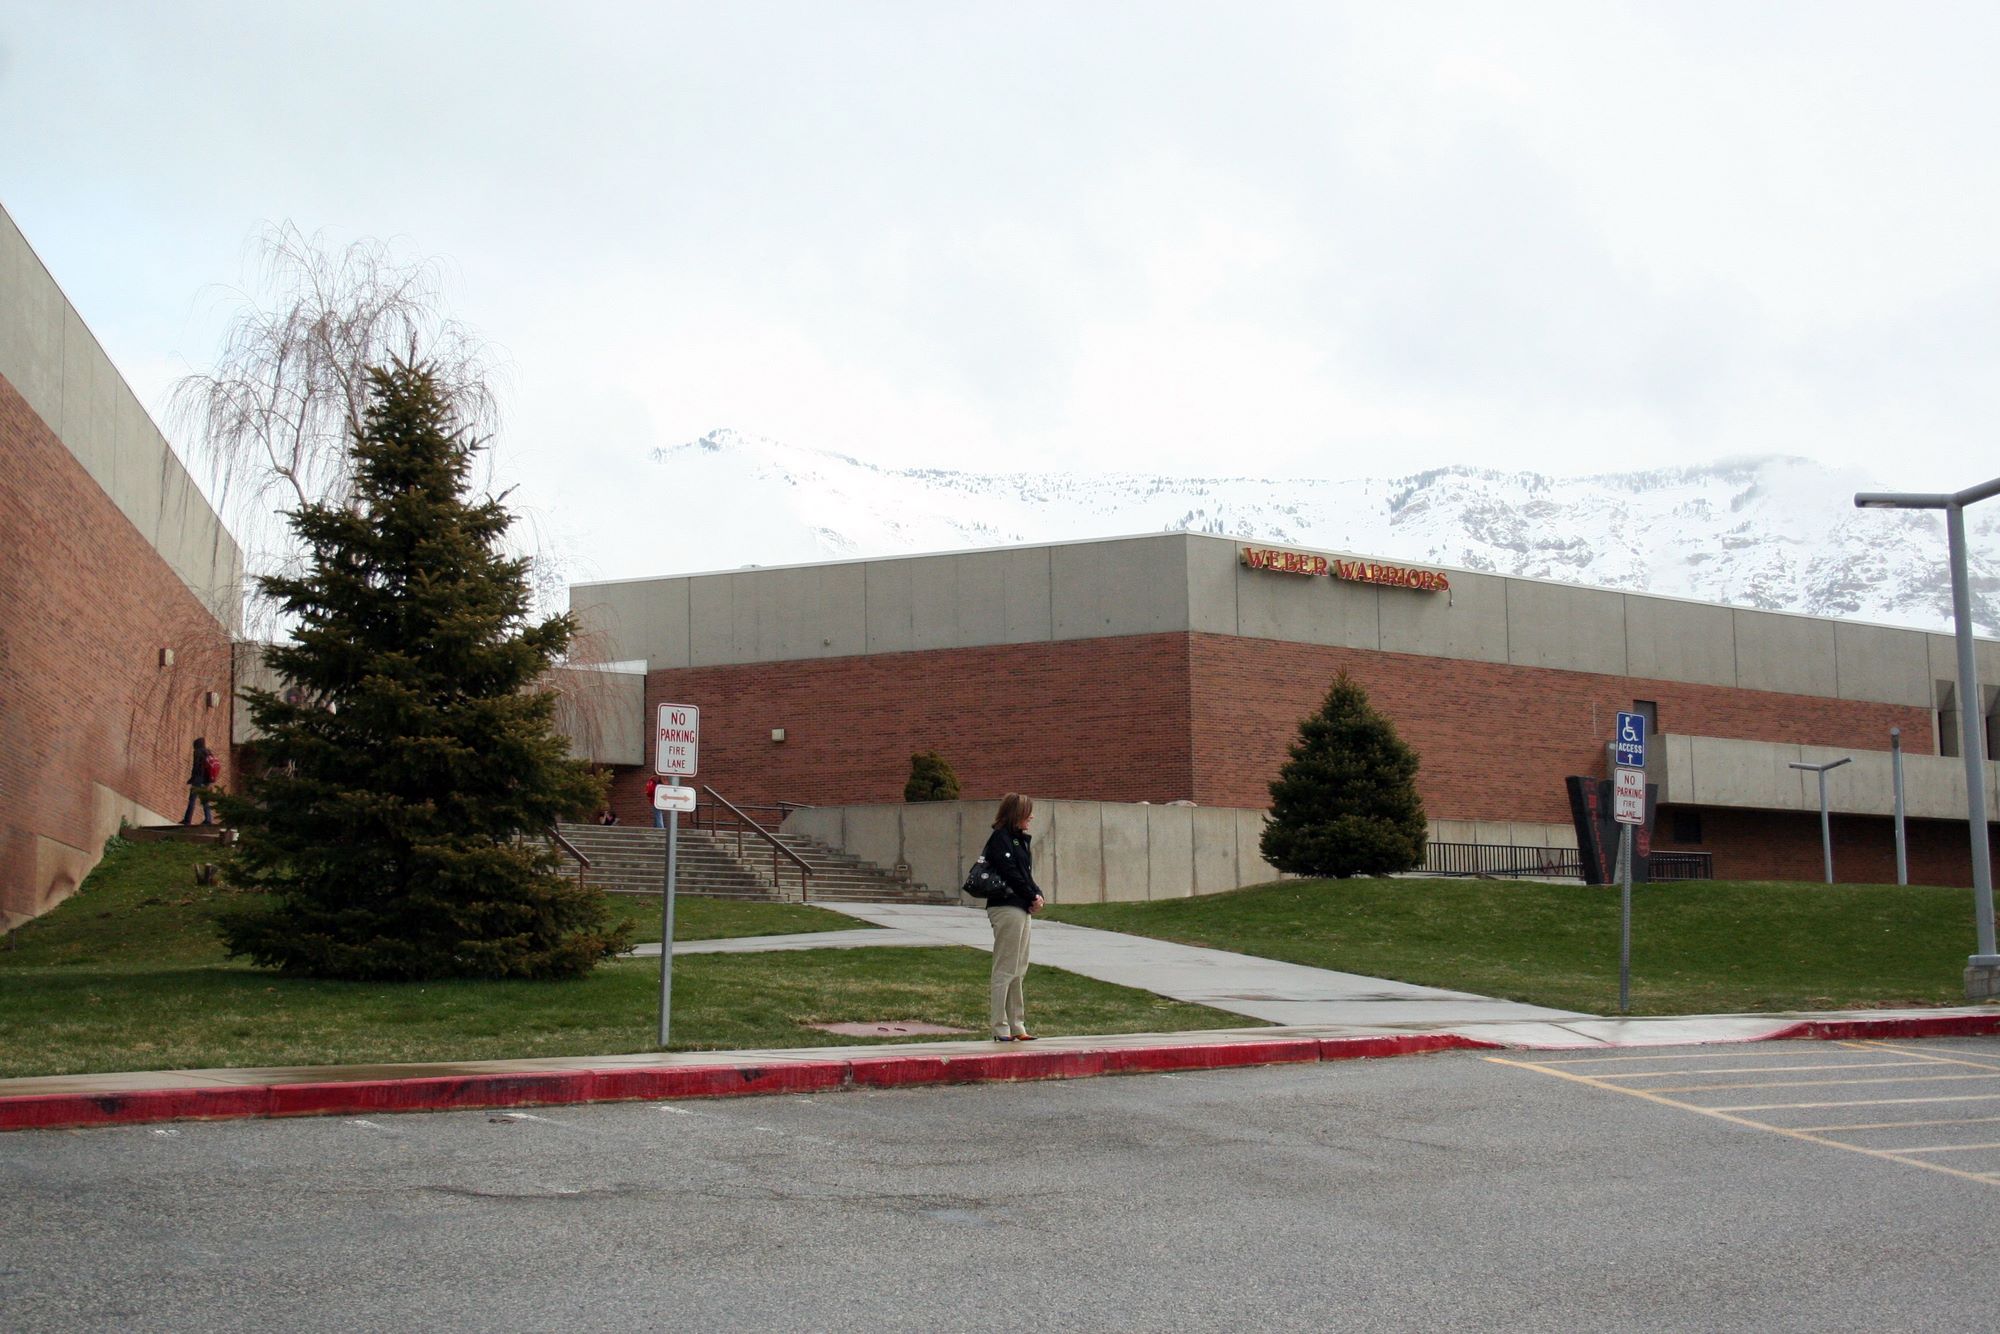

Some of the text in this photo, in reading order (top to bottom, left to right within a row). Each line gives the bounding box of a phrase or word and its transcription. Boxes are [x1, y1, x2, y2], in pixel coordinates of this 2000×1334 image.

[1243, 547, 1450, 593] WEBER WARRIORS
[671, 712, 685, 725] NO
[661, 729, 694, 743] PARKING
[669, 746, 685, 755] FIRE
[1618, 742, 1643, 754] ACCESS
[667, 760, 685, 768] LANE
[1624, 775, 1636, 786] NO
[1616, 787, 1642, 799] PARKING
[1623, 800, 1635, 808] FIRE
